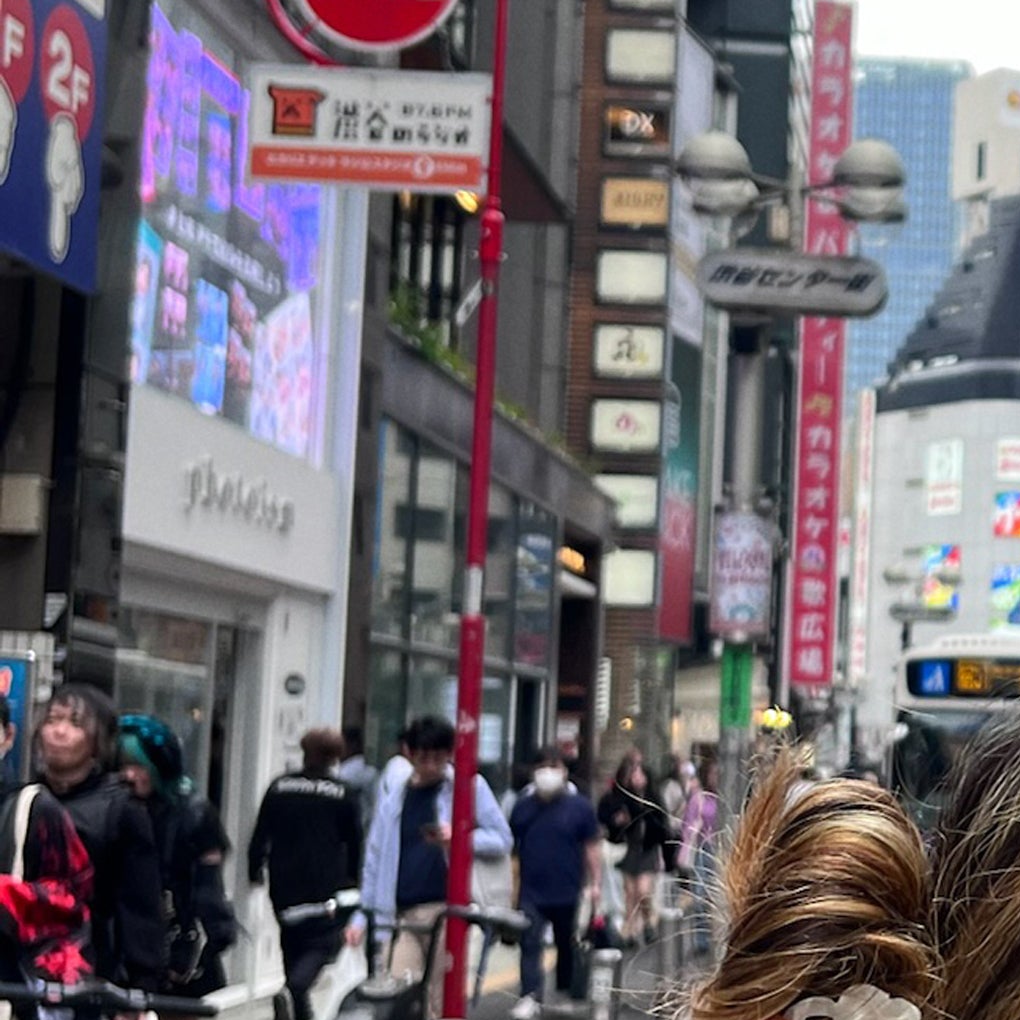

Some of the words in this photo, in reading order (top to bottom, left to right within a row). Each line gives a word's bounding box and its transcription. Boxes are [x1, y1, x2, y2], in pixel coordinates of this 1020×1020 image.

[0, 11, 26, 69] F
[47, 28, 91, 114] 2F
[803, 424, 832, 540] カラオケ
